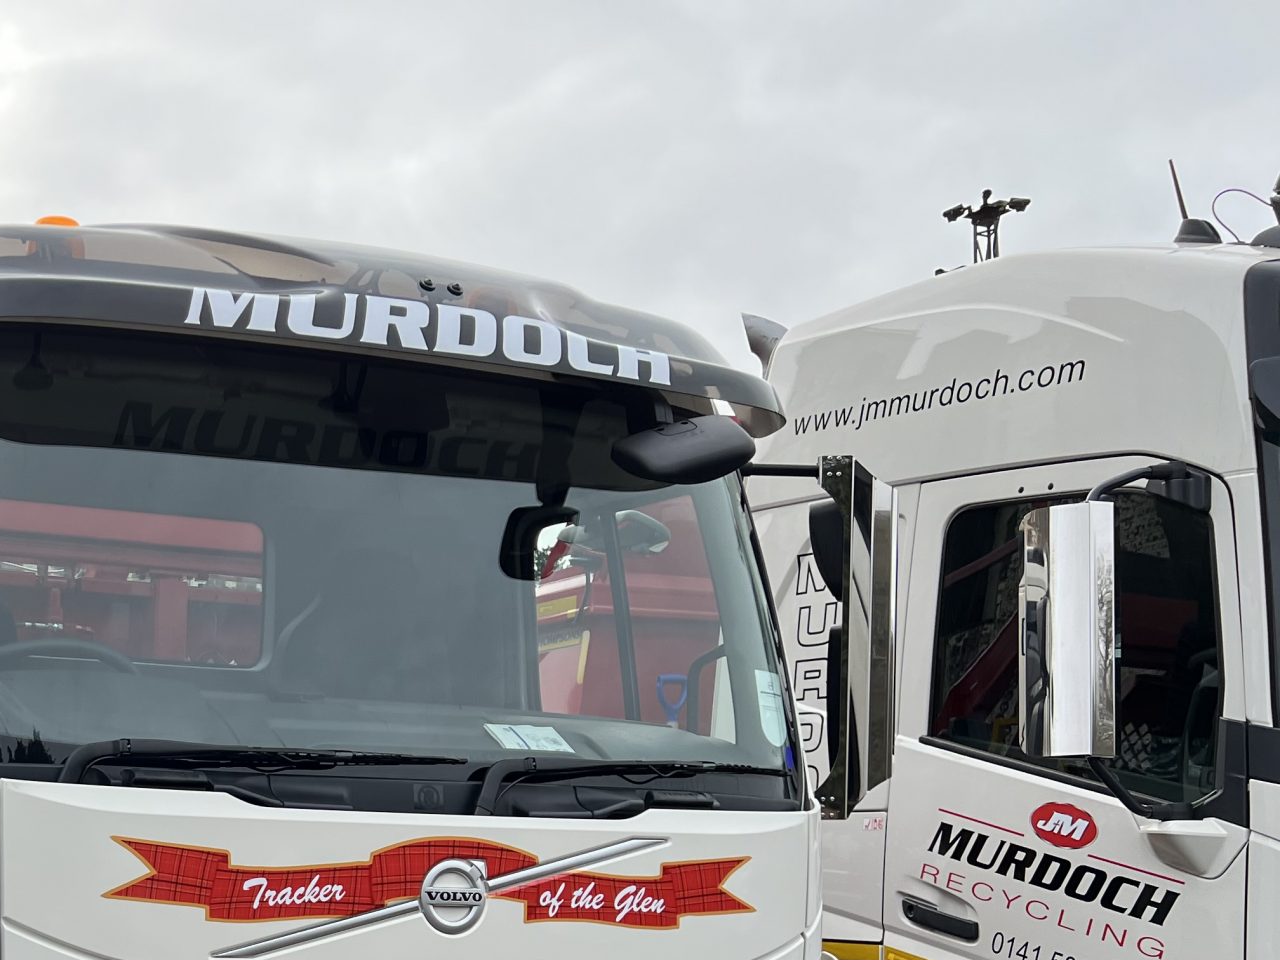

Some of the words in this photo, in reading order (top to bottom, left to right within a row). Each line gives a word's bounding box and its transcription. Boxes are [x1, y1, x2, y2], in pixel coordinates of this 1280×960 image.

[184, 287, 672, 386] MURDOCH
[793, 359, 1086, 436] www.jmmurdoch.com
[242, 874, 346, 909] Tracker
[538, 882, 565, 917] of
[570, 883, 606, 910] the
[613, 884, 666, 921] Glen
[424, 890, 483, 904] VOLVO
[920, 863, 1166, 960] RECYCLING
[927, 821, 1181, 926] MURDOCH
